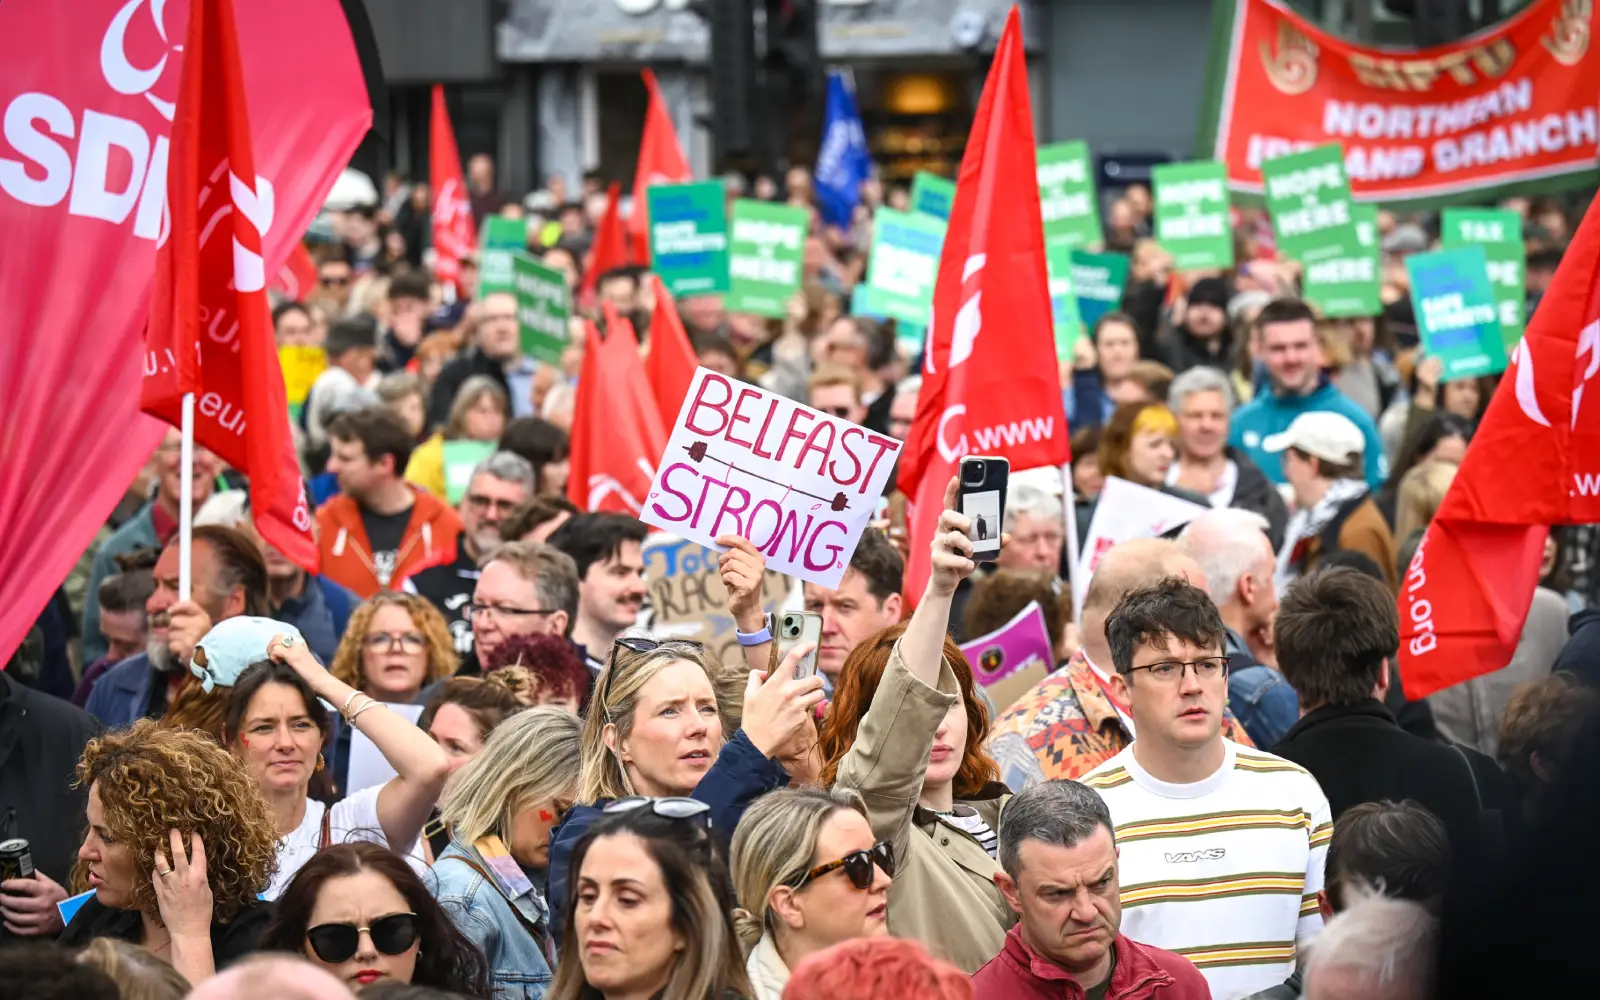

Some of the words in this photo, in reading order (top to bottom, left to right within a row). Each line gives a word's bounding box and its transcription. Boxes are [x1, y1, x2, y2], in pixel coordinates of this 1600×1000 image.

[1432, 107, 1597, 173] BRANCH
[685, 373, 900, 494] BELFAST
[651, 462, 848, 572] STRONG
[1164, 848, 1226, 863] VANS
